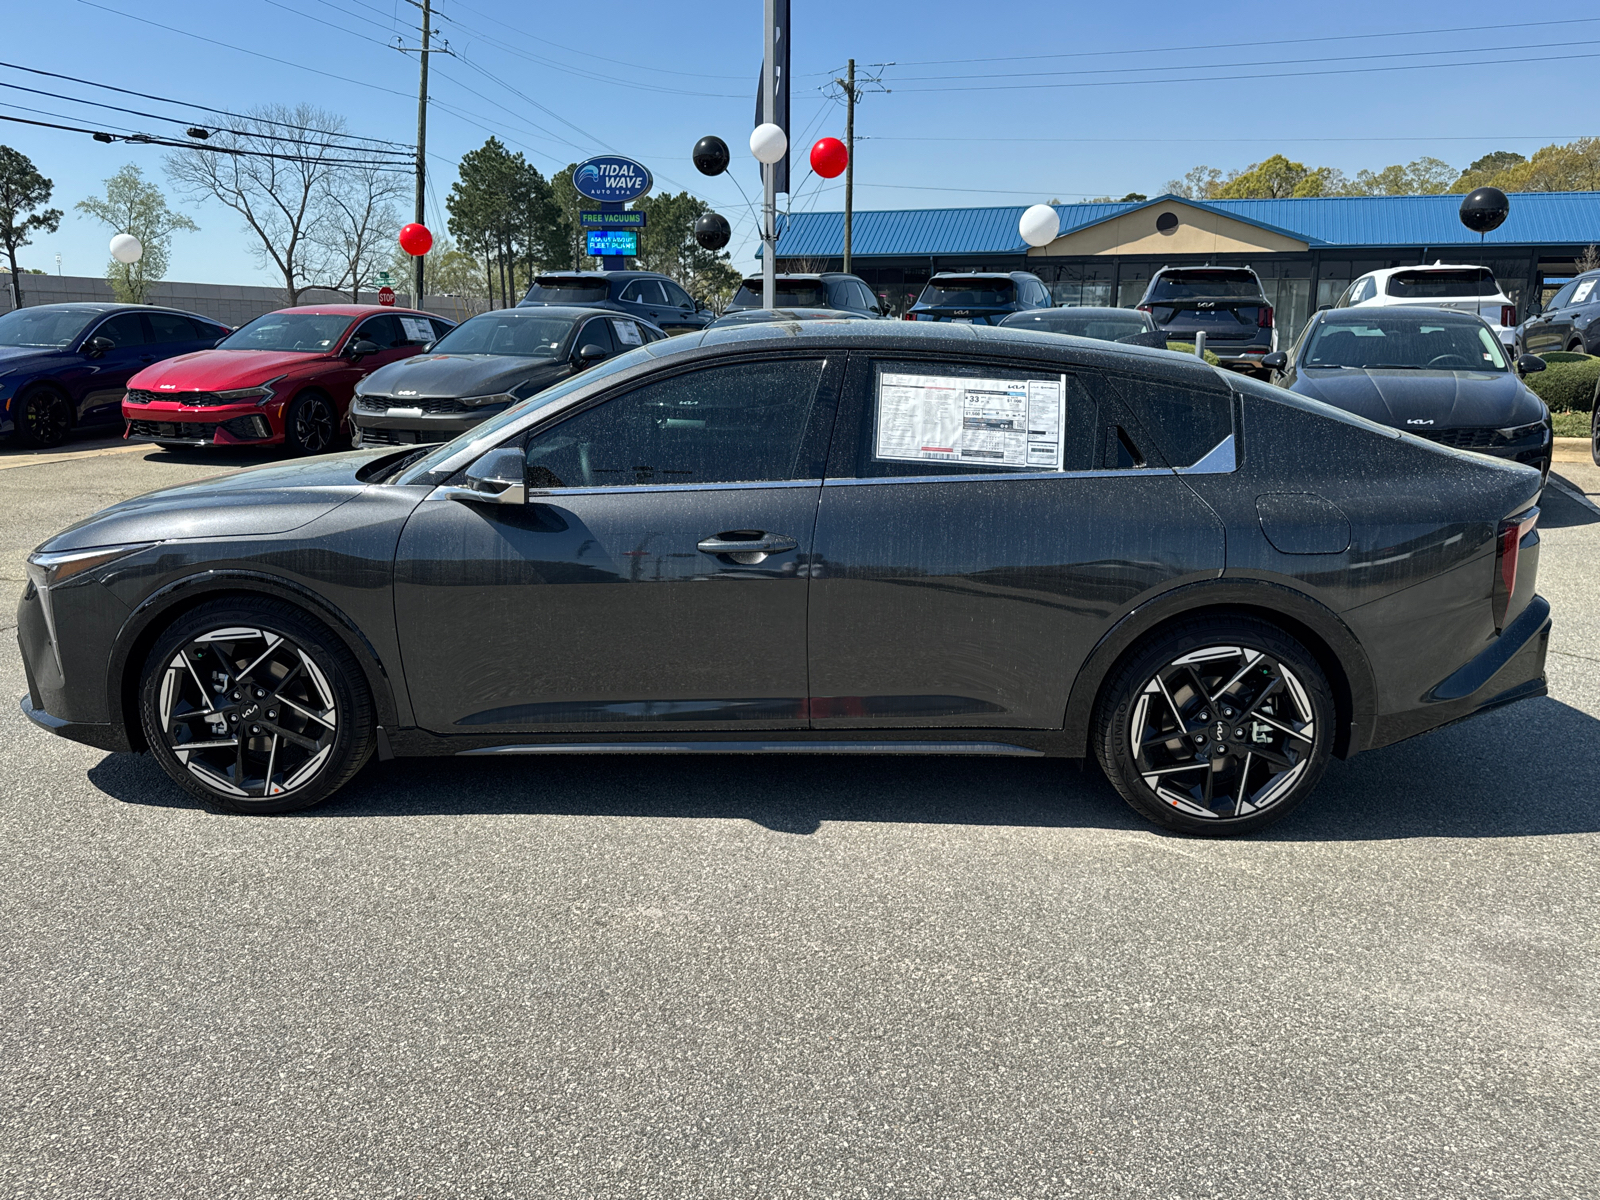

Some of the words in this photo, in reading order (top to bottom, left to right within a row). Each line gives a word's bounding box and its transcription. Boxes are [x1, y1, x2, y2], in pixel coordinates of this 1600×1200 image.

[599, 165, 635, 176] TIDAL
[605, 177, 643, 188] WAVE
[583, 214, 603, 222] FREE
[604, 214, 641, 222] VACUUMS
[379, 293, 395, 302] STOP
[969, 395, 980, 403] 33
[1117, 702, 1127, 756] KUMHO
